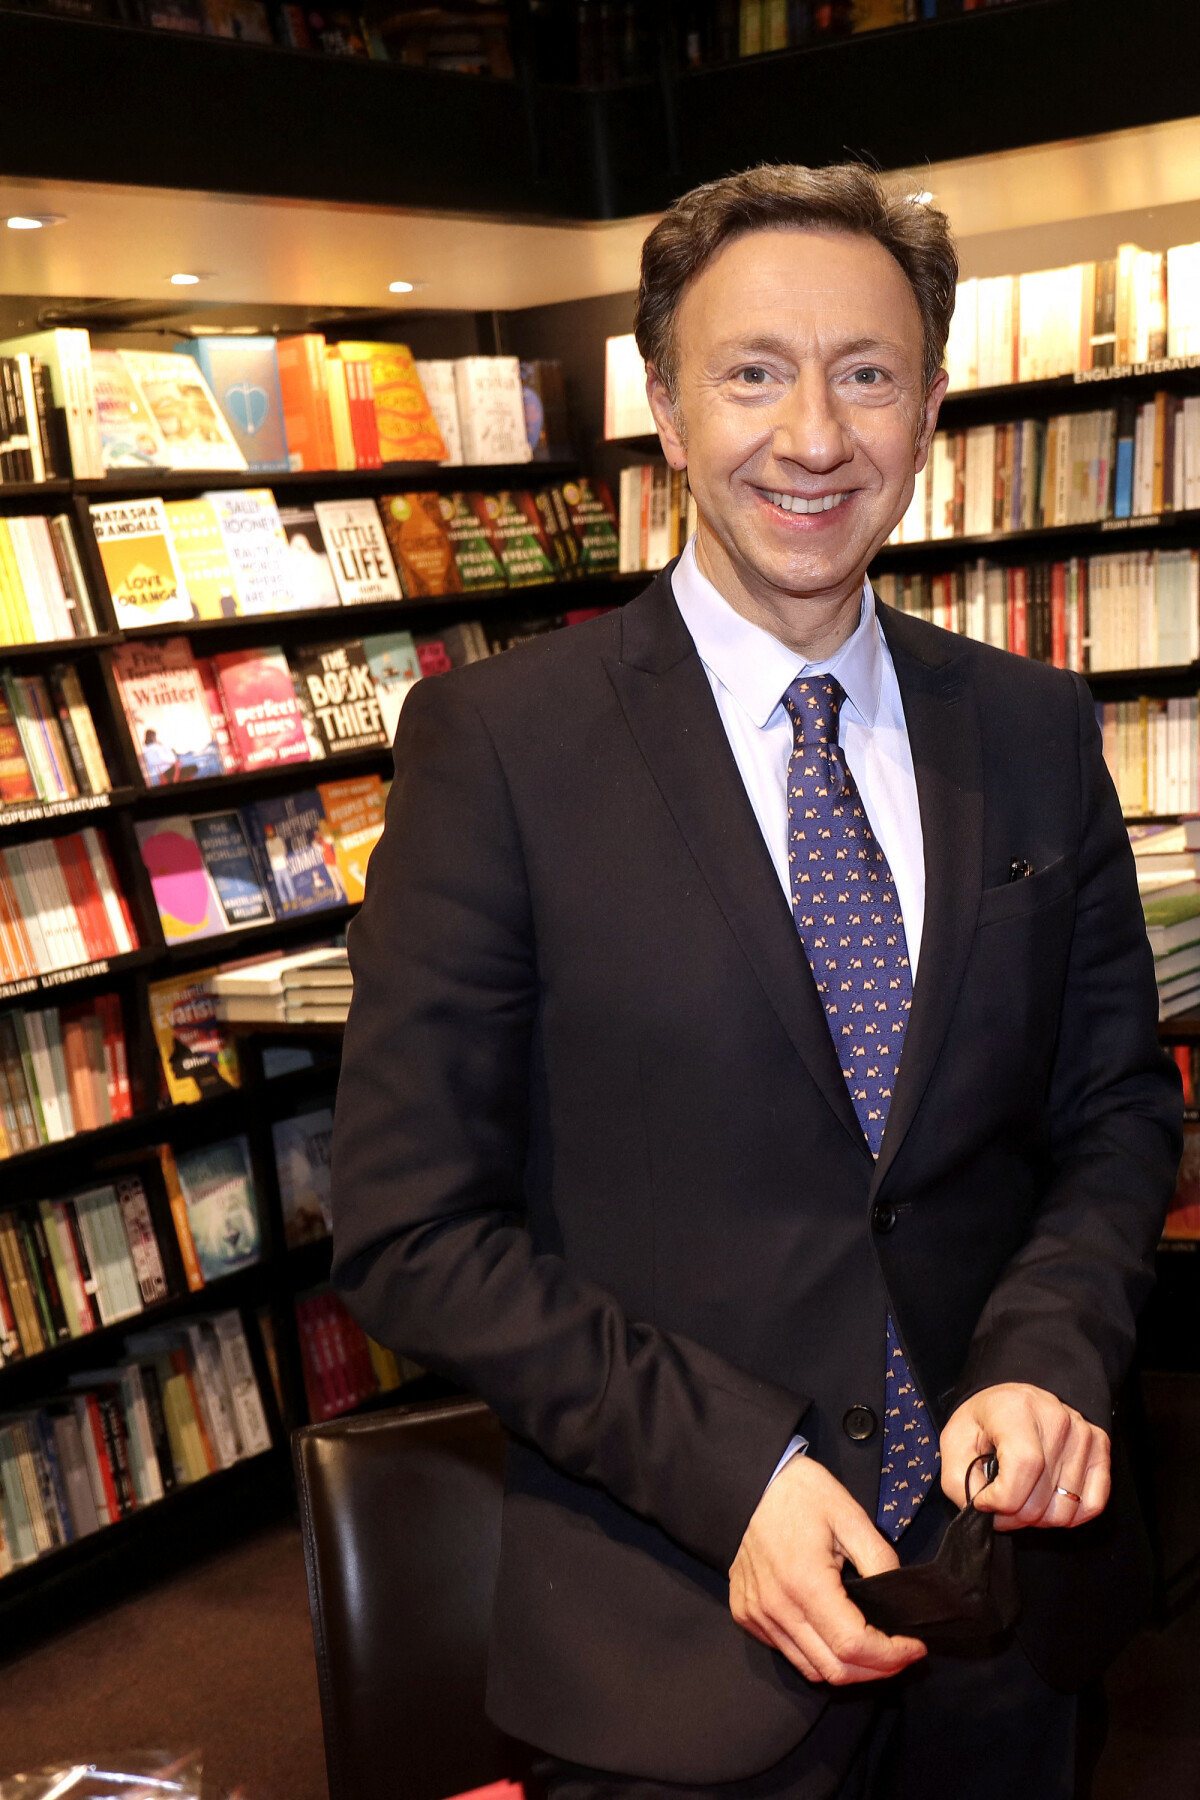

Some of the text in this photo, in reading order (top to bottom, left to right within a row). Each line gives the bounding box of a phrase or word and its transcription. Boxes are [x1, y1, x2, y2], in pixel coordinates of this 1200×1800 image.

[1074, 365, 1132, 384] ENGLISH
[93, 505, 159, 524] NATASHA
[95, 520, 163, 538] RANDALL
[338, 547, 388, 581] LIFE
[124, 574, 164, 591] LOVE
[117, 587, 178, 607] ORANGE
[320, 648, 350, 672] THE
[132, 686, 196, 707] Winter
[306, 663, 375, 708] BOOK
[234, 698, 297, 727] perfect
[314, 698, 382, 741] THIEF
[246, 718, 297, 739] tunes
[43, 794, 111, 818] LITERATURE
[0, 960, 110, 998] ALIAN LITERATURE
[154, 999, 217, 1030] Evarist
